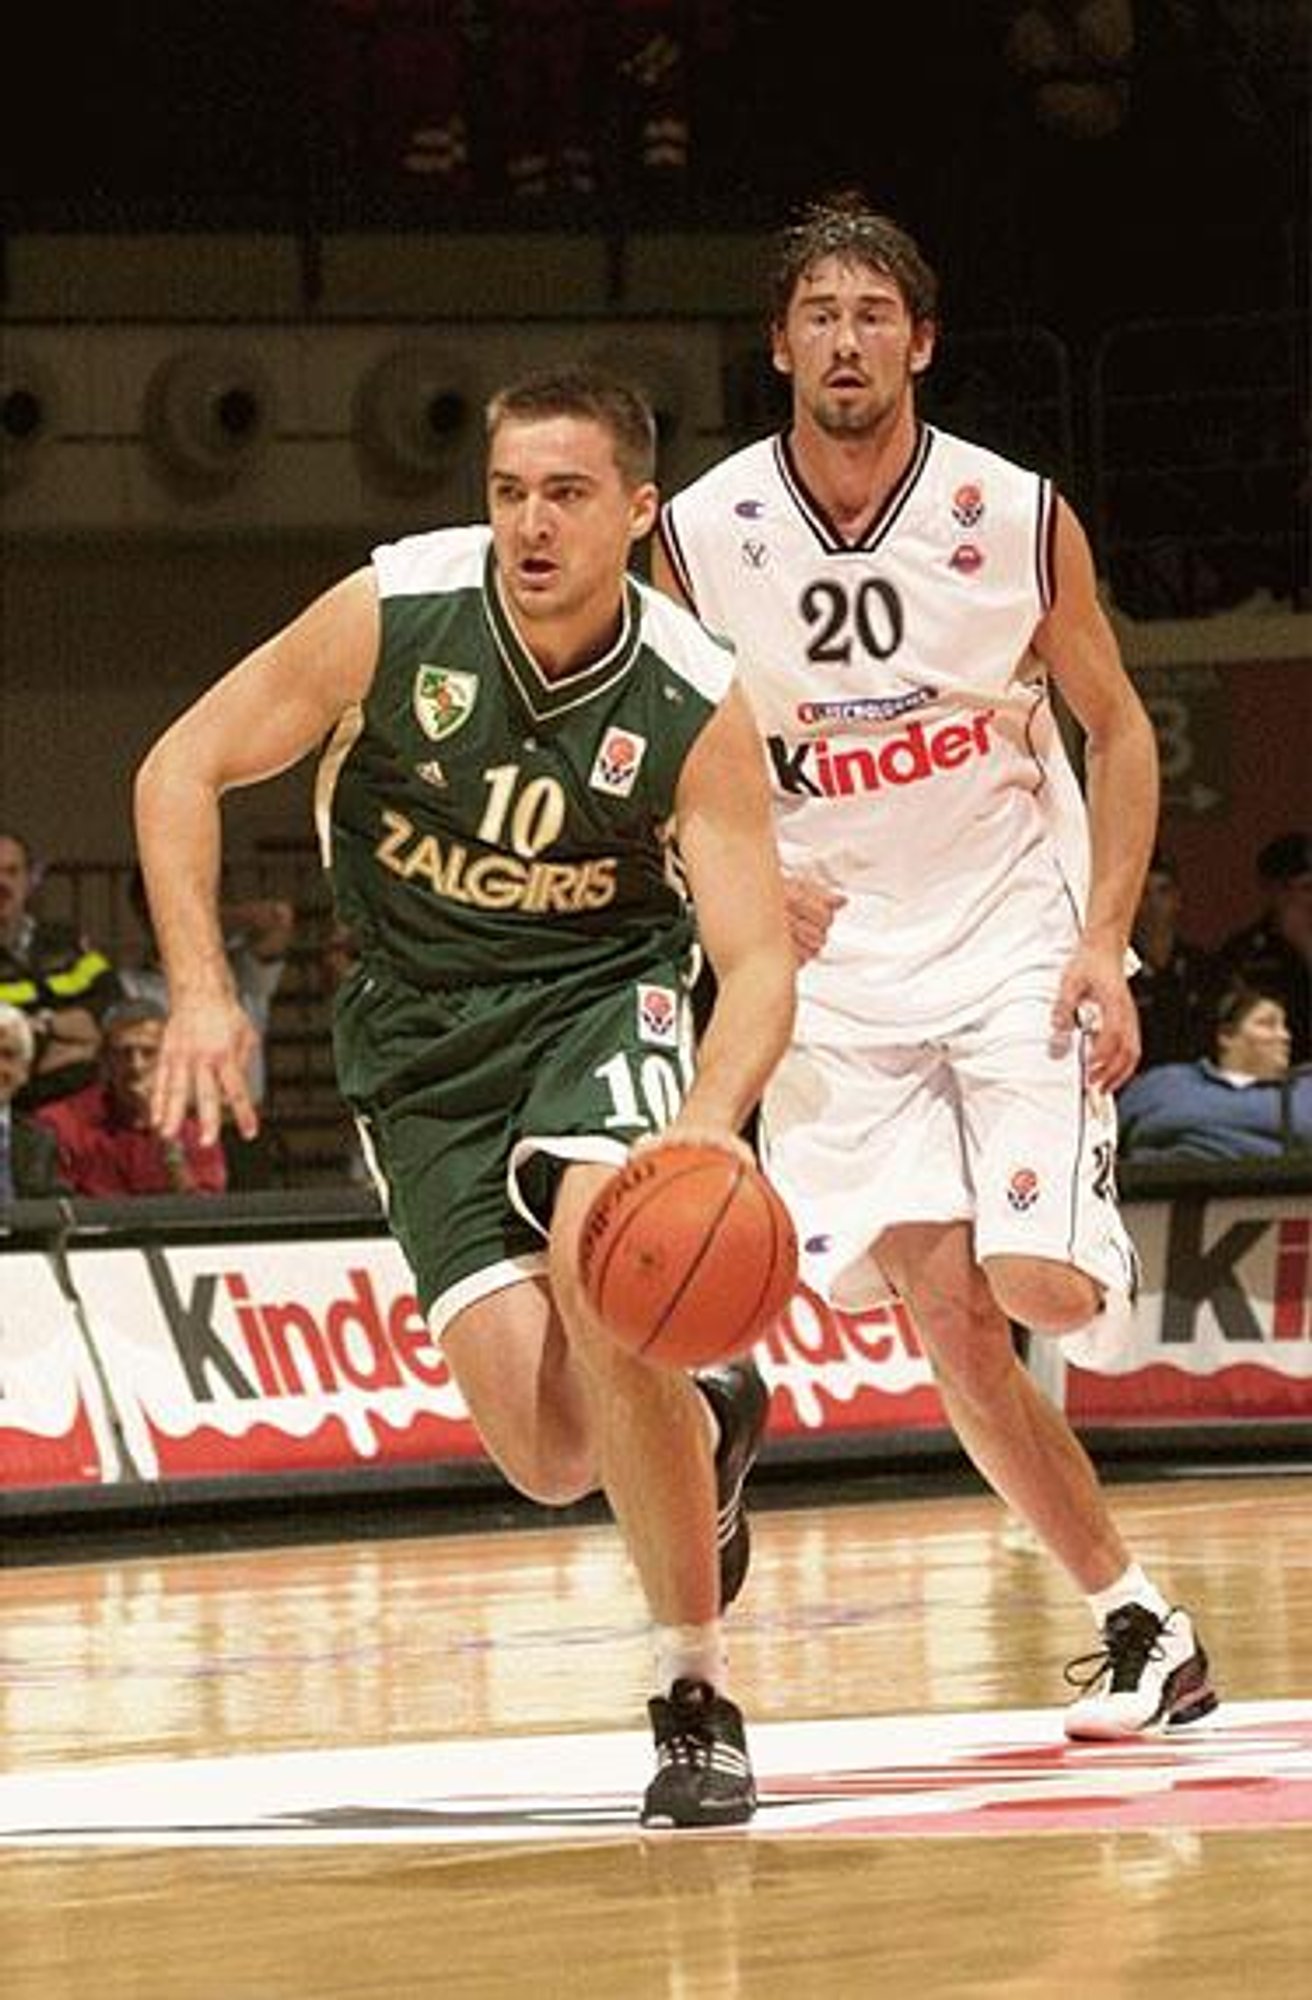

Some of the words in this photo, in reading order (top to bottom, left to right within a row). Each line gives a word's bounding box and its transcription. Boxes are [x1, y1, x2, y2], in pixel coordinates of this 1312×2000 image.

[799, 577, 905, 665] 20
[475, 764, 565, 859] 10
[375, 810, 618, 914] ZALGIRIS
[595, 1051, 683, 1135] 10
